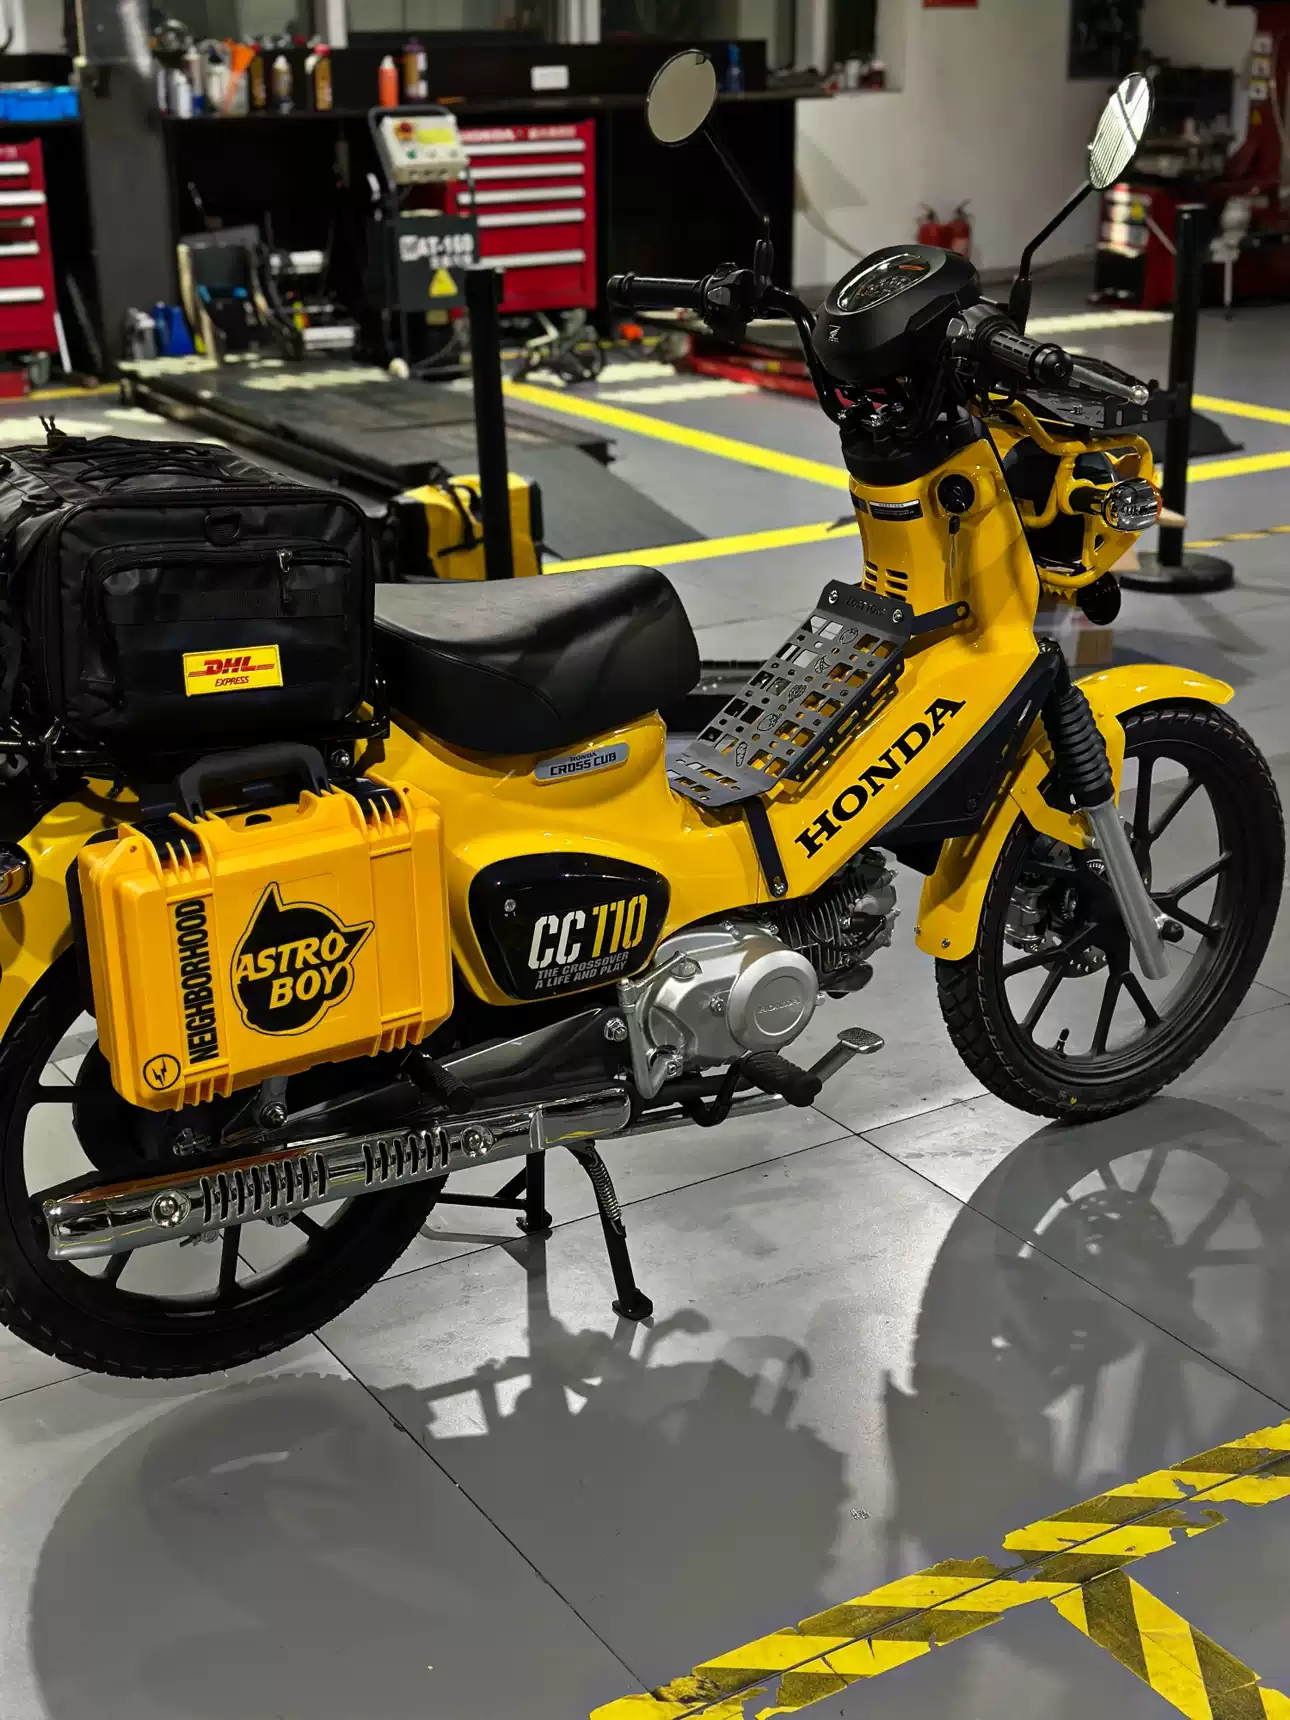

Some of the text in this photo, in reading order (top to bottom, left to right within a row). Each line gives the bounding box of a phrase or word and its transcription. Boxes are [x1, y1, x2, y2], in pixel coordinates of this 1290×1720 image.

[204, 656, 256, 675] DHL
[214, 676, 250, 687] EXPRESS
[550, 752, 617, 776] CROSS CUB
[570, 752, 597, 762] HONDA
[794, 697, 966, 859] HONDA
[528, 894, 648, 970] CC 110
[236, 929, 350, 985] ASTRO
[537, 951, 630, 979] THE CROSSOVER
[174, 899, 219, 1064] NEIGHBORHOOD
[268, 963, 339, 1010] BOY
[534, 961, 628, 990] A LIFE AND PLAY
